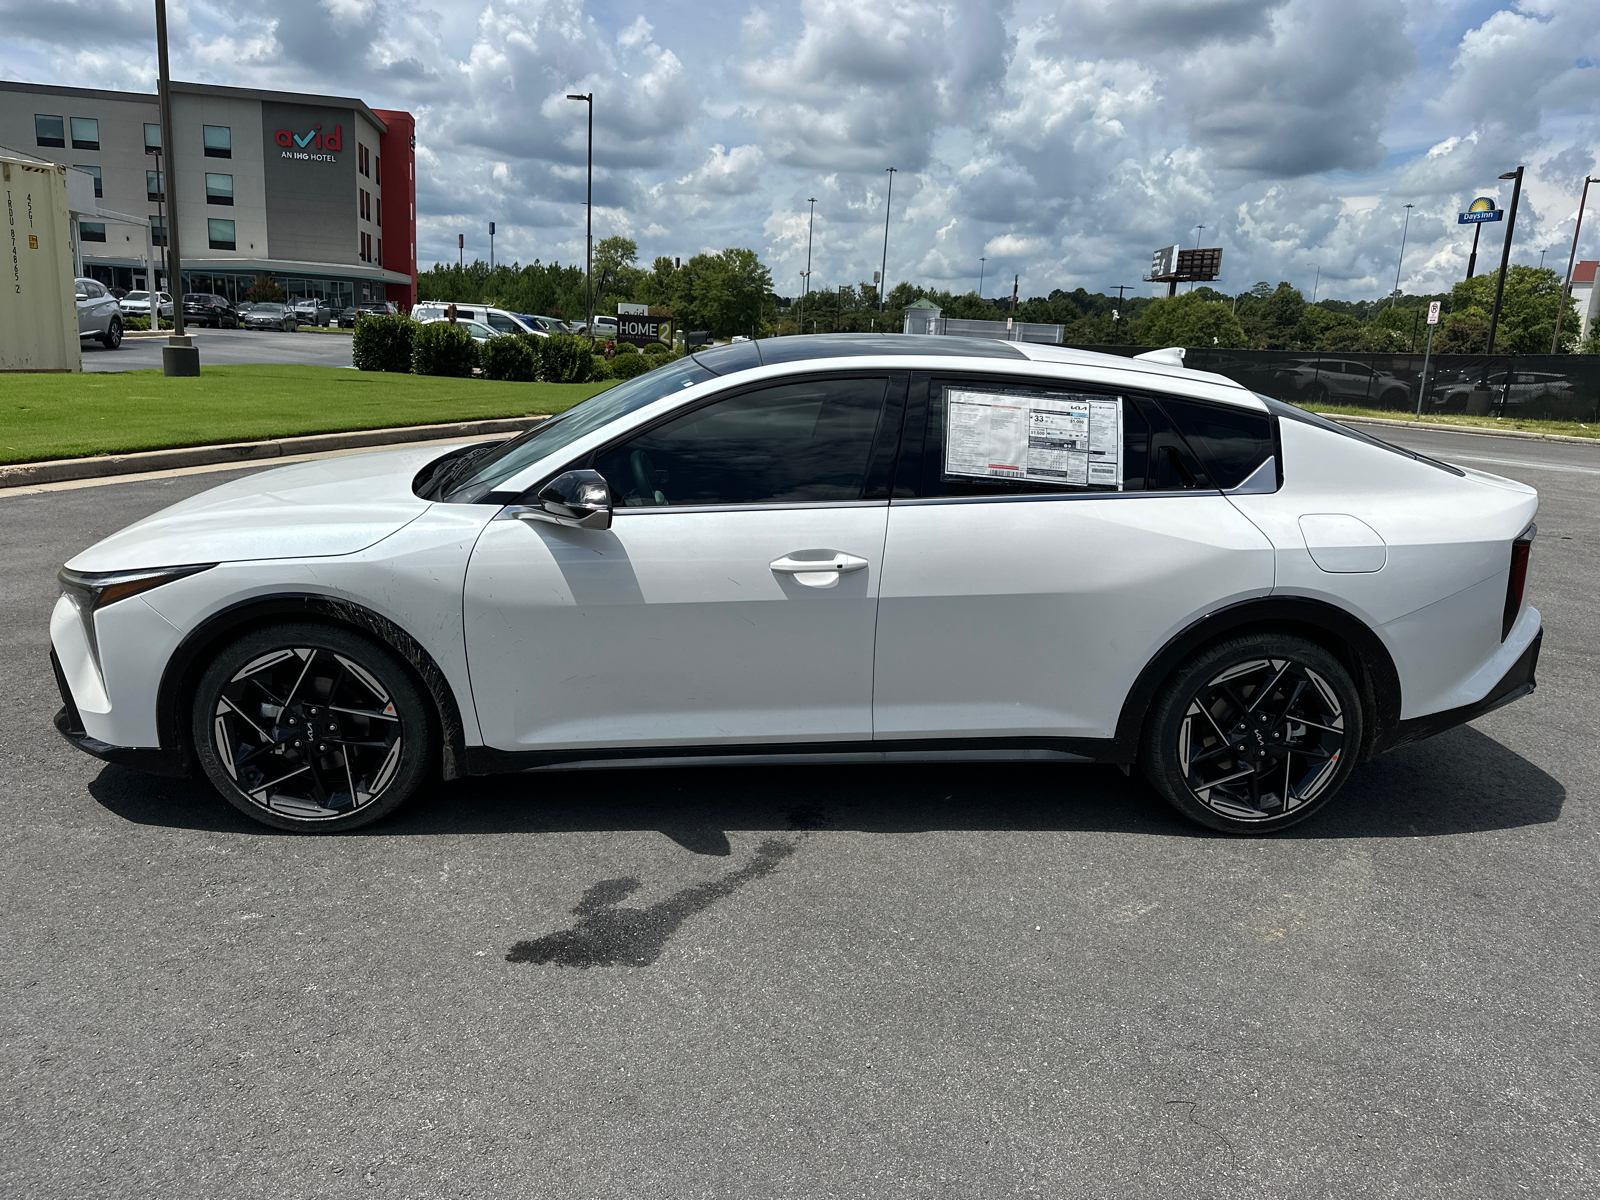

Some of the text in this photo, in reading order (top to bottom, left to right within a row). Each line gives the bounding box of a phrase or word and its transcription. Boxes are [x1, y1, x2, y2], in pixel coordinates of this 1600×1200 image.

[275, 123, 342, 151] avid
[281, 151, 337, 163] AN IHG HOTEL
[620, 321, 670, 344] HOME 2
